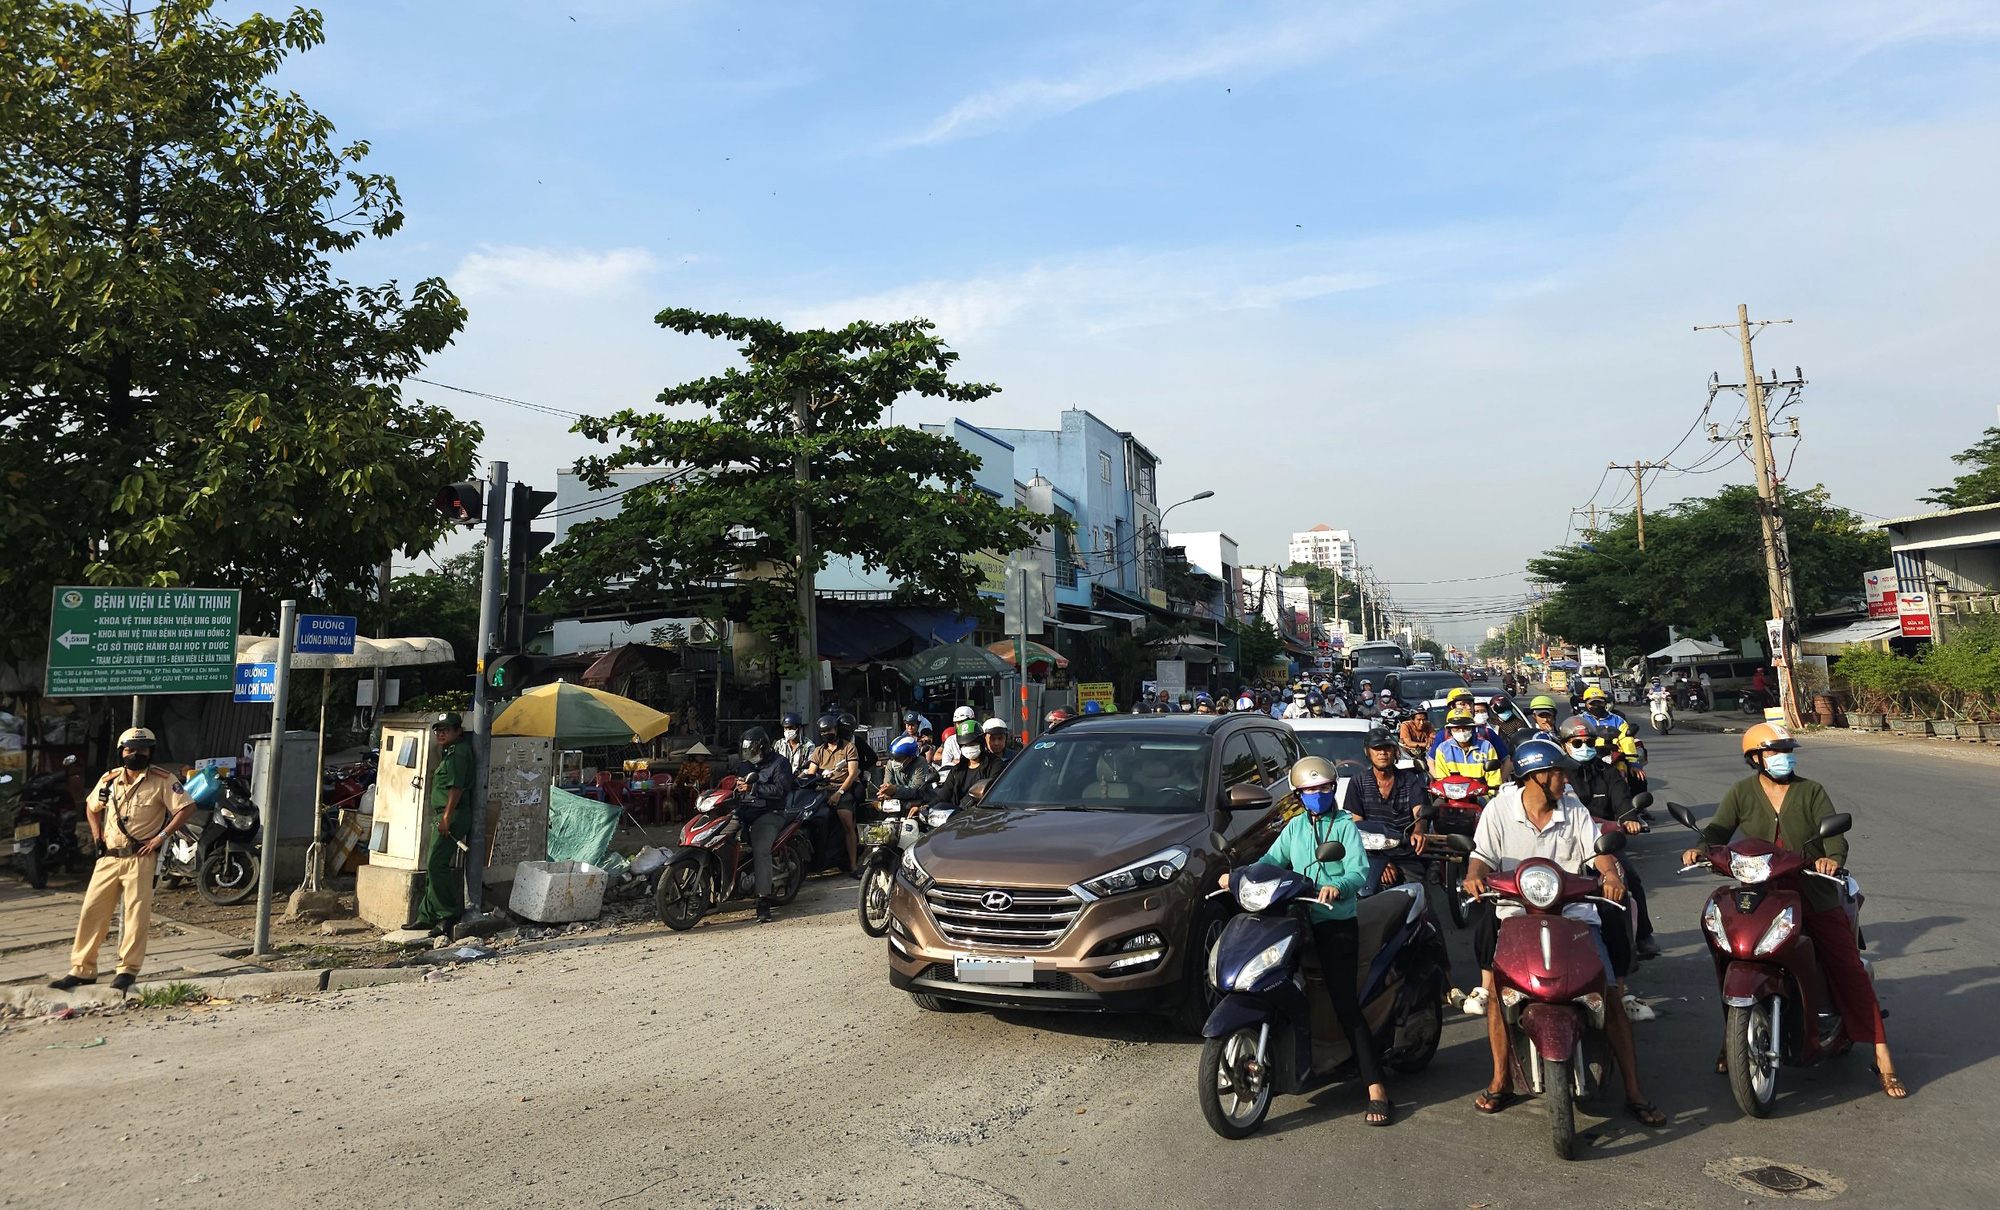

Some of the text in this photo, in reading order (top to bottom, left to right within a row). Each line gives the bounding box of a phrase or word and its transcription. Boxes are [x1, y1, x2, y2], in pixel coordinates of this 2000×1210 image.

[94, 592, 231, 612] BỆNH VIỆN LÊ VĂN THỊNH
[98, 614, 232, 626] KHOA VỆ TINH BỆNH VIỆN UNG BƯỚU
[312, 619, 345, 630] ĐƯỜNG
[97, 626, 231, 639] KHOA NHI VỆ TINH BỆNH VIỆN NHI ĐỒNG 2
[323, 634, 338, 648] ĐỊNH
[339, 632, 352, 646] CỦA
[96, 640, 230, 653] CƠ SỞ THỰC HÀNH ĐẠI HỌC Y DƯỢC
[143, 655, 156, 664] TINH
[156, 655, 167, 664] 115
[244, 666, 268, 678] ĐƯỜNG
[1278, 669, 1287, 678] XE
[235, 680, 274, 698] MAI CHÍ THỌ
